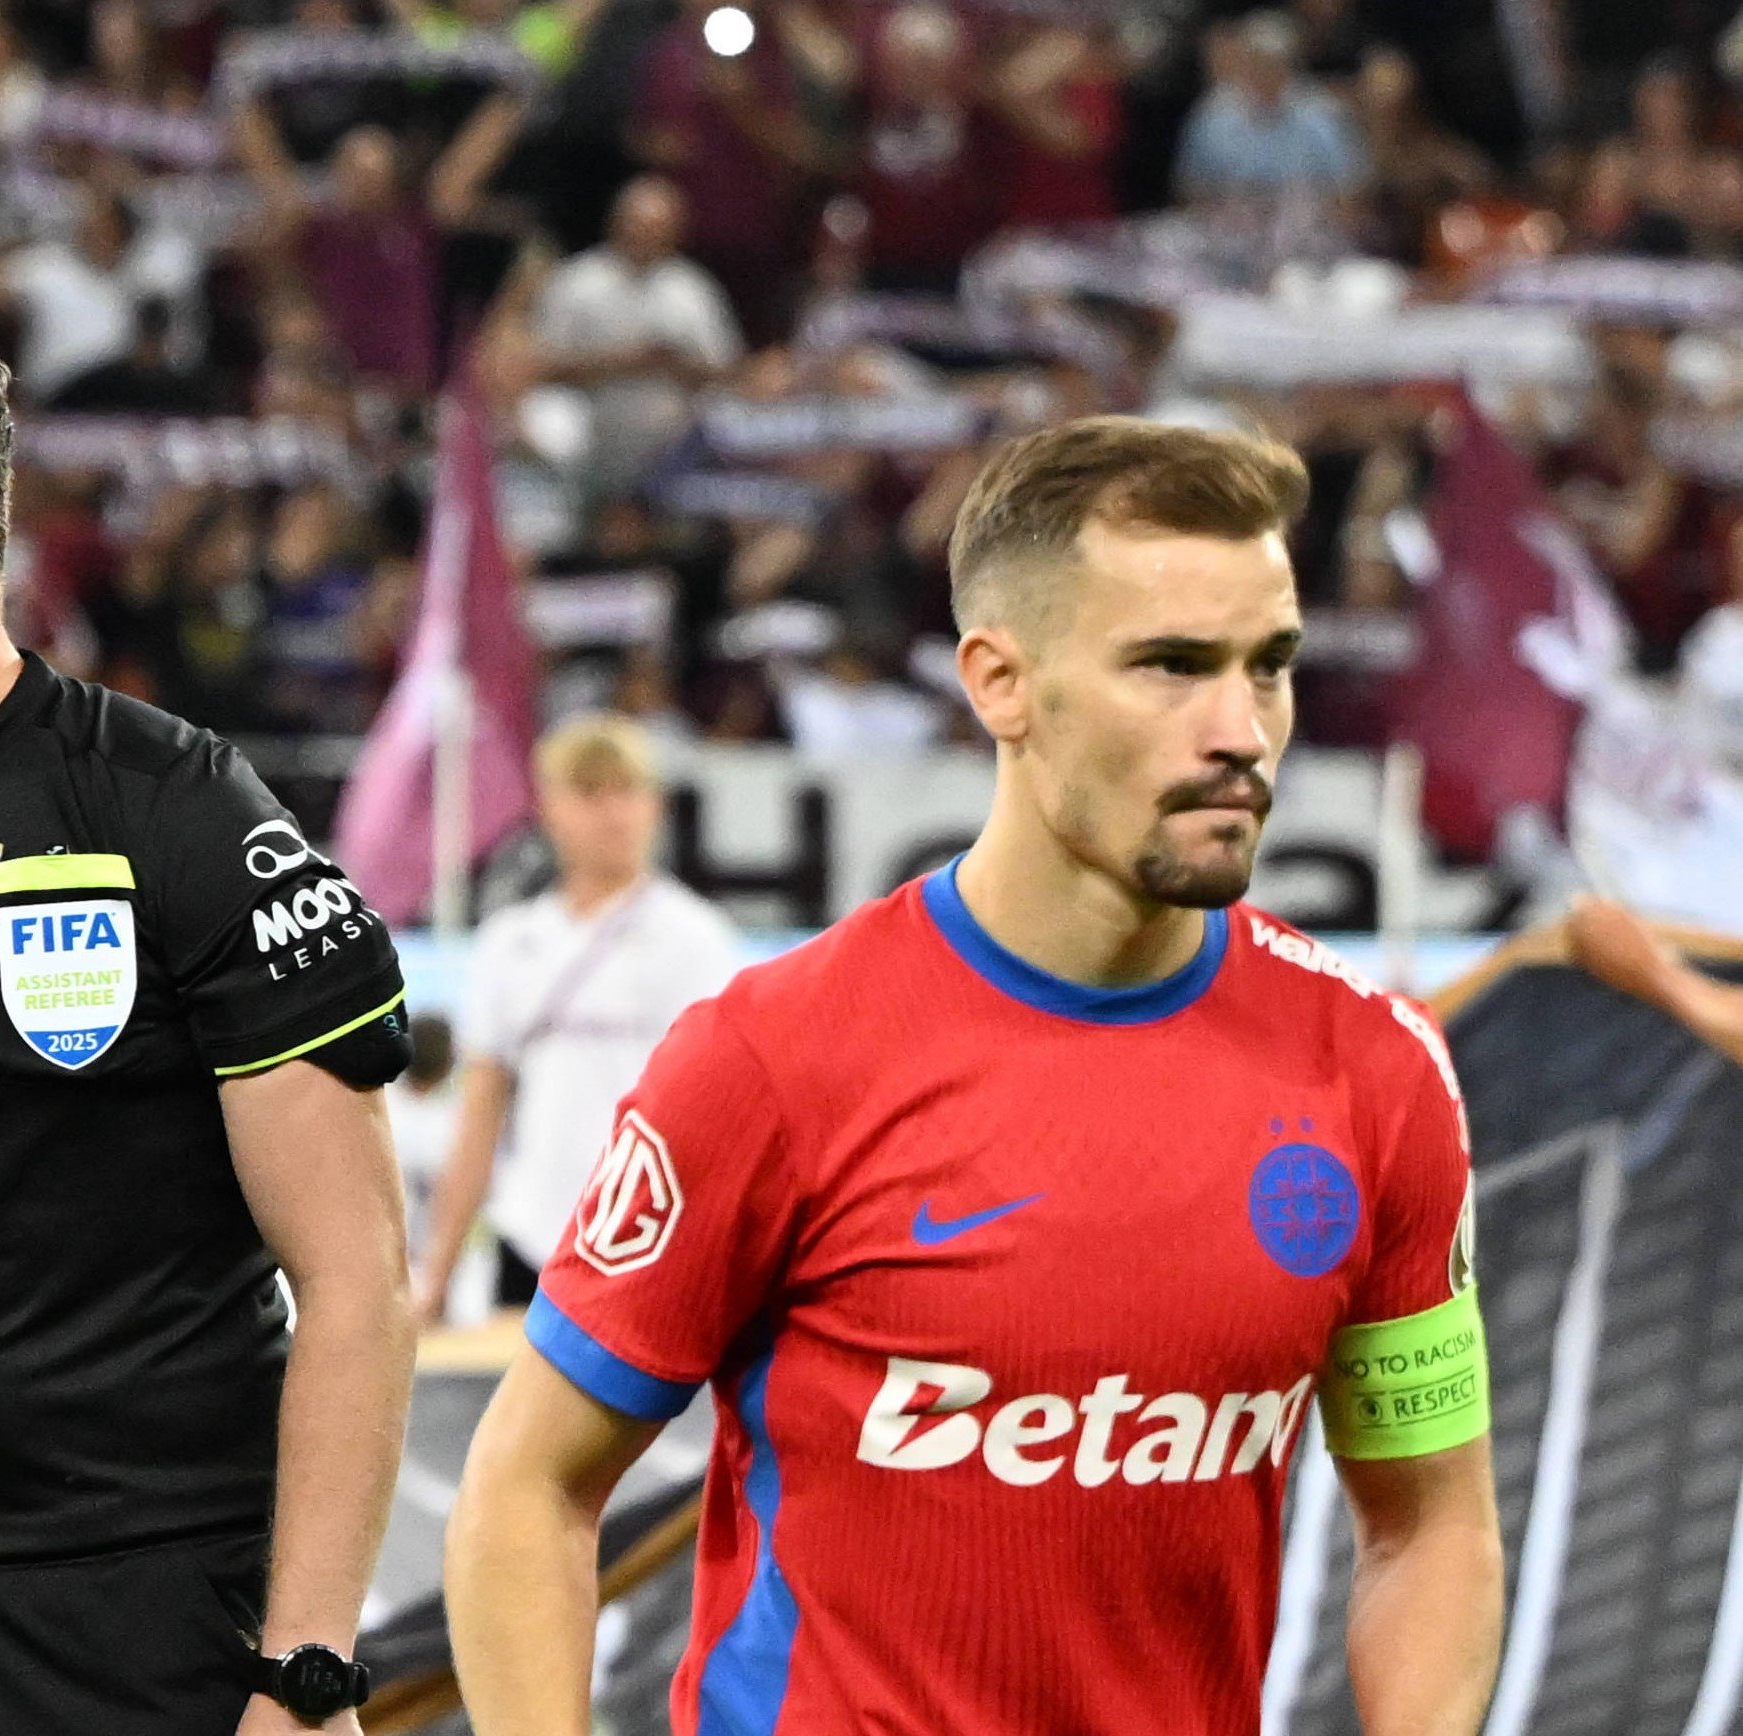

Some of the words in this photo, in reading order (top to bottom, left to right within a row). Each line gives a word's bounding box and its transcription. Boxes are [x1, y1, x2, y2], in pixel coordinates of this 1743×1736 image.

[11, 912, 121, 955] FIFA
[16, 969, 123, 991] ASSISTANT
[24, 988, 116, 1010] REFEREE
[46, 1032, 98, 1053] 2025
[1375, 1353, 1408, 1376] TO
[1413, 1328, 1477, 1369] RACISM
[1393, 1373, 1476, 1419] RESPECT
